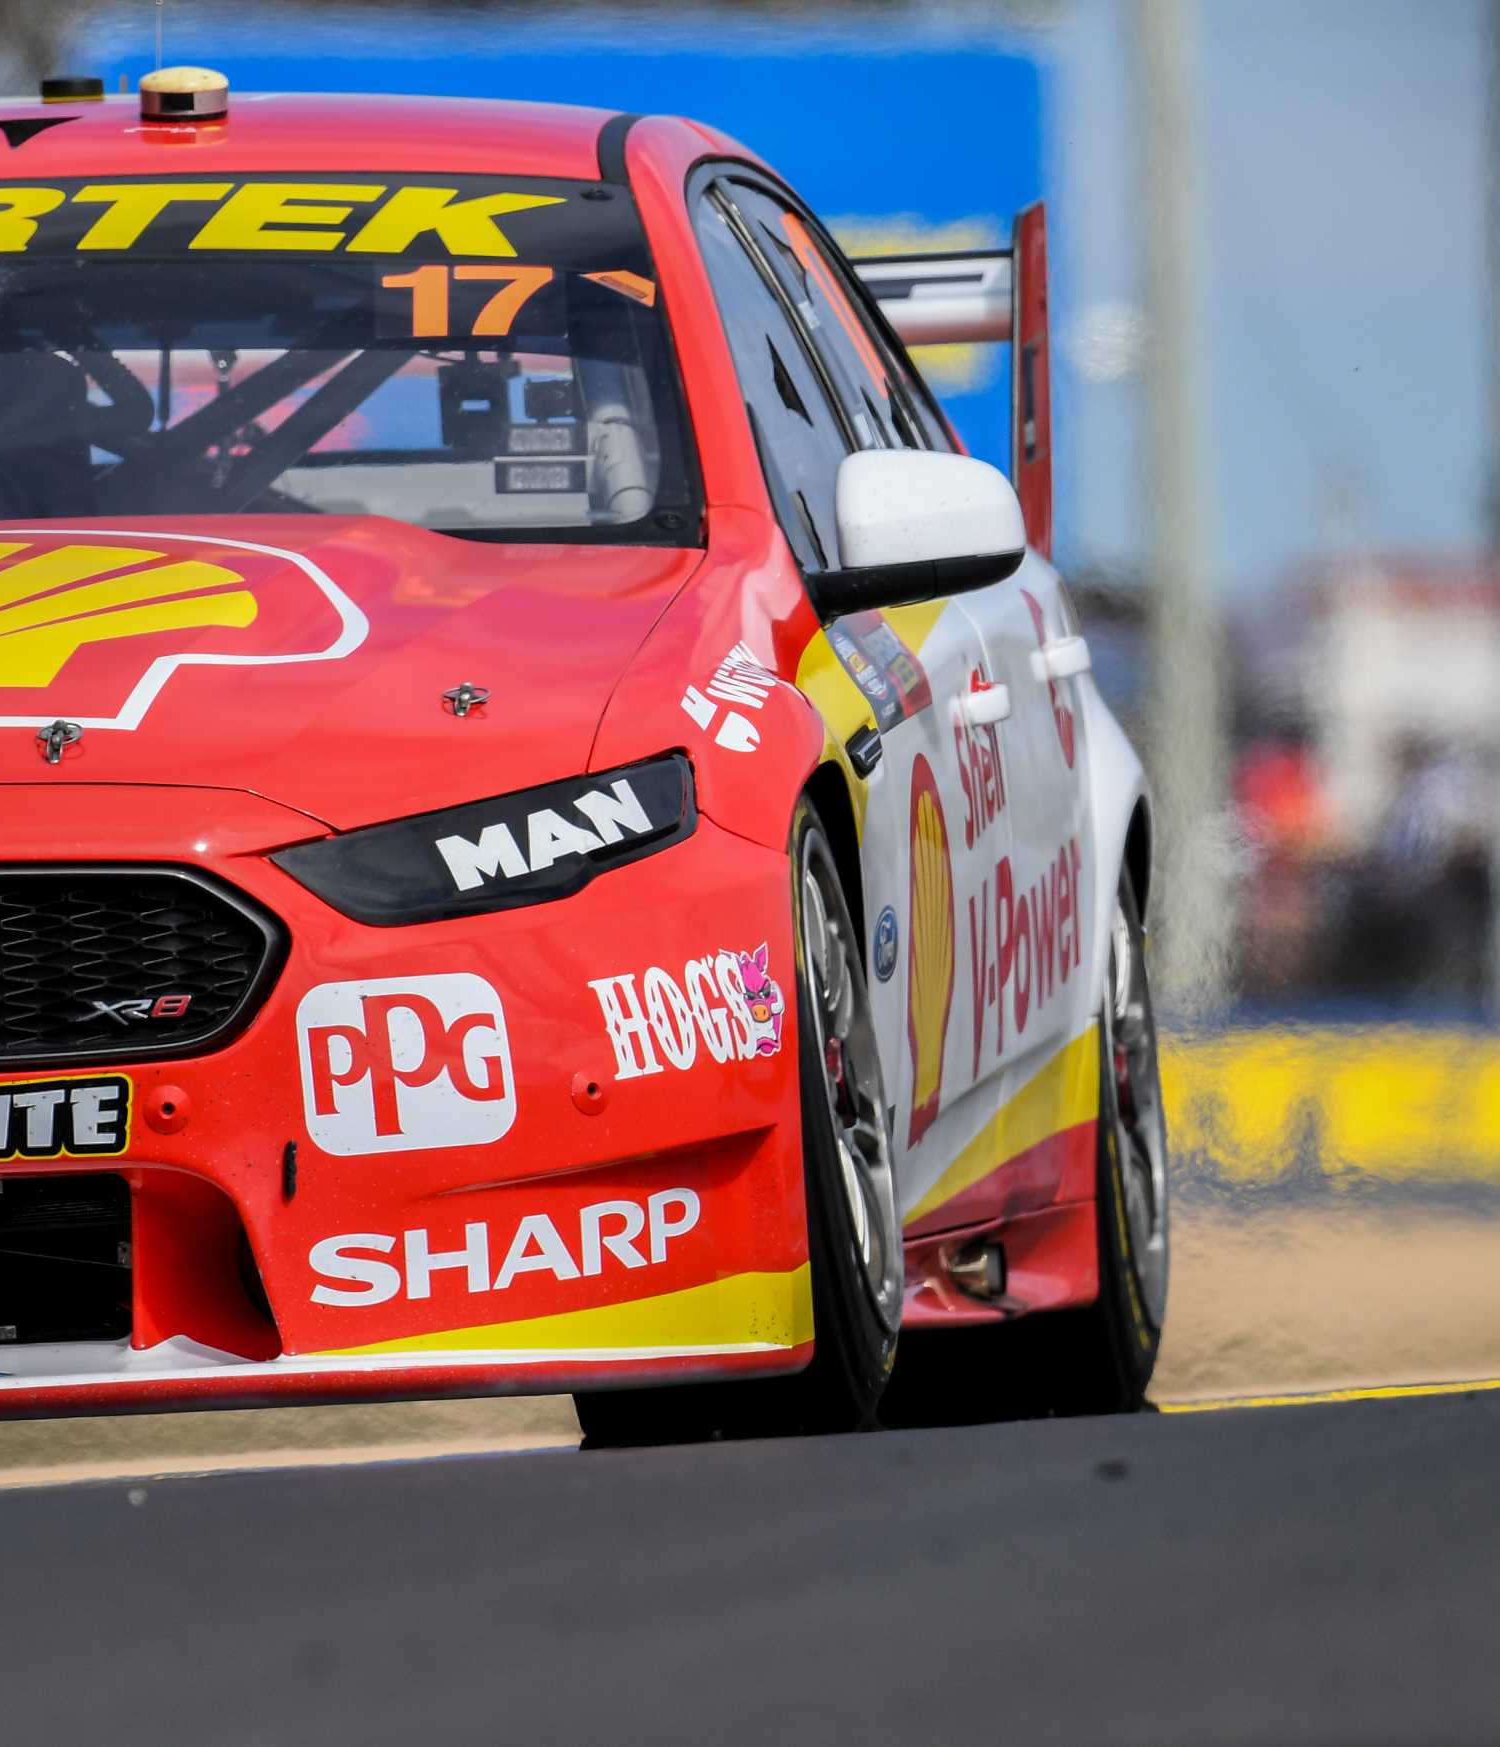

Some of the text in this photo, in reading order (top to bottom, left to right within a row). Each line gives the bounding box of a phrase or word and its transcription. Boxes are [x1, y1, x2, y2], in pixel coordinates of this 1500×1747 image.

[381, 264, 554, 337] 17
[435, 779, 654, 891] MAN
[72, 994, 193, 1026] XR8
[969, 837, 1082, 1081] V-Power
[307, 992, 507, 1138] PPG
[308, 1187, 701, 1308] SHARP
